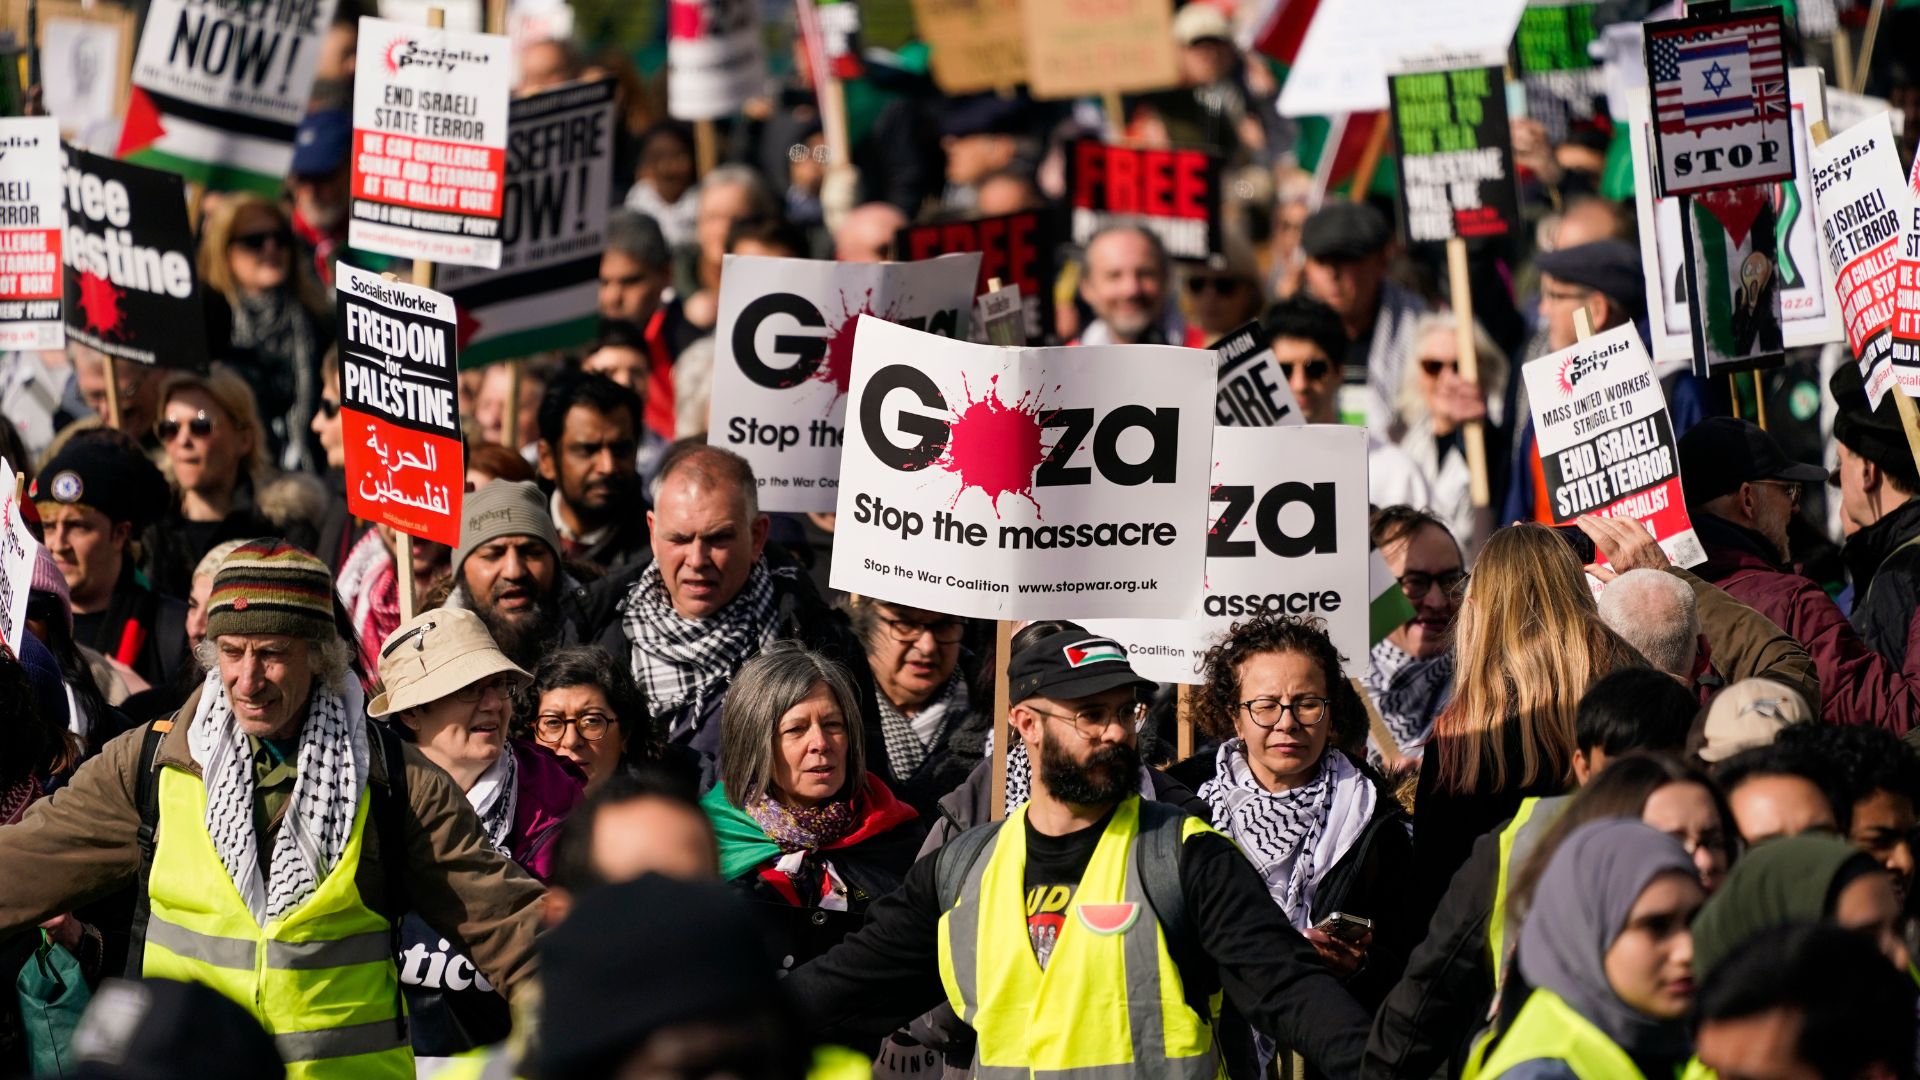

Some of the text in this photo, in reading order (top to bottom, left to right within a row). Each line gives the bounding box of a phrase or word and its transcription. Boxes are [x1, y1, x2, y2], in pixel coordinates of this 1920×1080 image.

[168, 9, 302, 95] NOW!
[406, 40, 489, 63] Socialist
[384, 85, 477, 117] END ISRAELI
[374, 108, 484, 141] STATE TERROR
[362, 134, 384, 155] WE
[414, 142, 490, 170] CHALLENGE
[1674, 140, 1779, 178] STOP
[62, 164, 130, 228] ree
[1075, 138, 1209, 220] FREE
[1834, 188, 1886, 234] ISRAELI
[1846, 209, 1900, 256] TERROR
[1783, 298, 1813, 309] aza
[346, 302, 446, 368] FREEDOM
[1573, 340, 1630, 370] Socialist
[385, 355, 401, 378] for
[345, 361, 455, 430] PALESTINE
[1543, 370, 1651, 428] MASS UNITED WORKERS'
[728, 417, 799, 452] Stop
[1574, 400, 1632, 435] STRUGGLE TO
[366, 425, 437, 472] الحرية
[1558, 417, 1659, 483] END ISRAELI
[359, 468, 450, 516] لفلسطين
[771, 477, 789, 487] the
[793, 478, 815, 488] War
[1556, 445, 1672, 517] STATE TERROR
[854, 493, 1177, 549] Stop the massacre
[1611, 486, 1669, 520] SOCIALIST
[864, 558, 1158, 597] Stop the War Coalition www.stopwar.org.uk
[1129, 643, 1185, 657] Coalition
[399, 938, 495, 992] tic
